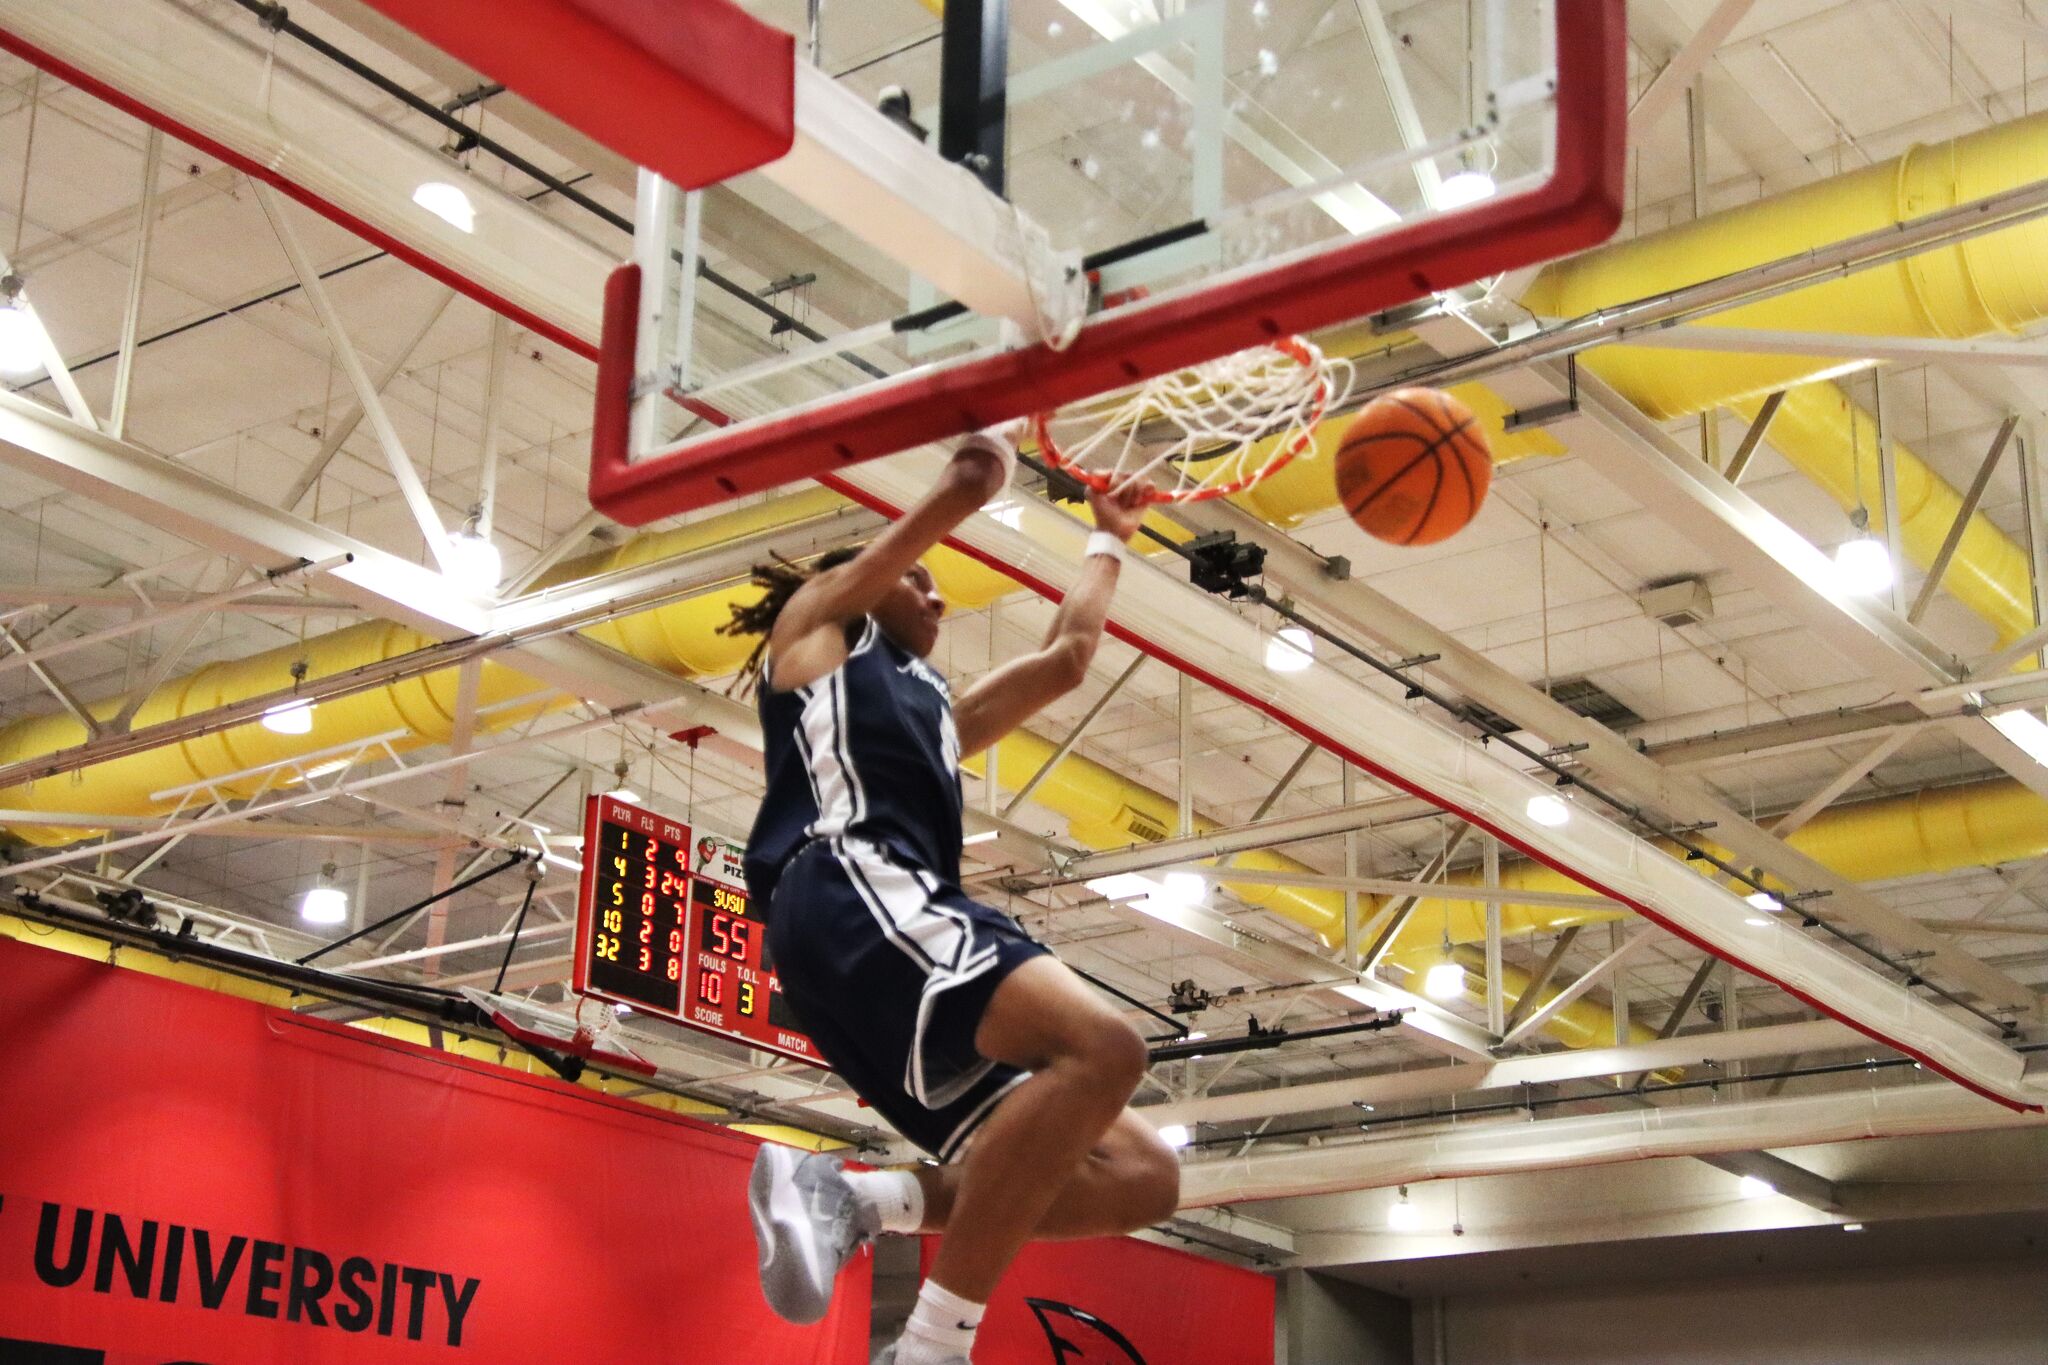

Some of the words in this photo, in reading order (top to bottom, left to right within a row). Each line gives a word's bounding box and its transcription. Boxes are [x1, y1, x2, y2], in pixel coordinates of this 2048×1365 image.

[613, 805, 632, 823] PLYR
[641, 816, 655, 832] FLS
[664, 824, 682, 841] PTS
[621, 832, 629, 850] 1
[645, 837, 659, 862] 2
[675, 849, 688, 871] 9
[614, 856, 627, 877] 4
[644, 865, 657, 889] 3
[661, 872, 687, 897] 24
[724, 863, 744, 879] PIZ
[612, 882, 624, 905] 5
[641, 893, 655, 916] 0
[673, 902, 685, 925] 7
[603, 909, 622, 933] 10
[639, 920, 653, 943] 2
[669, 930, 683, 953] 0
[712, 915, 747, 960] 55
[596, 933, 620, 961] 32
[639, 946, 652, 971] 3
[667, 957, 681, 980] 8
[698, 953, 727, 974] FOULS
[700, 971, 721, 1004] 10
[737, 965, 760, 985] T.O.L.
[694, 1006, 723, 1026] SCORE
[741, 982, 754, 1014] 3
[778, 1032, 807, 1053] MATCH
[34, 1201, 481, 1348] UNIVERSITY
